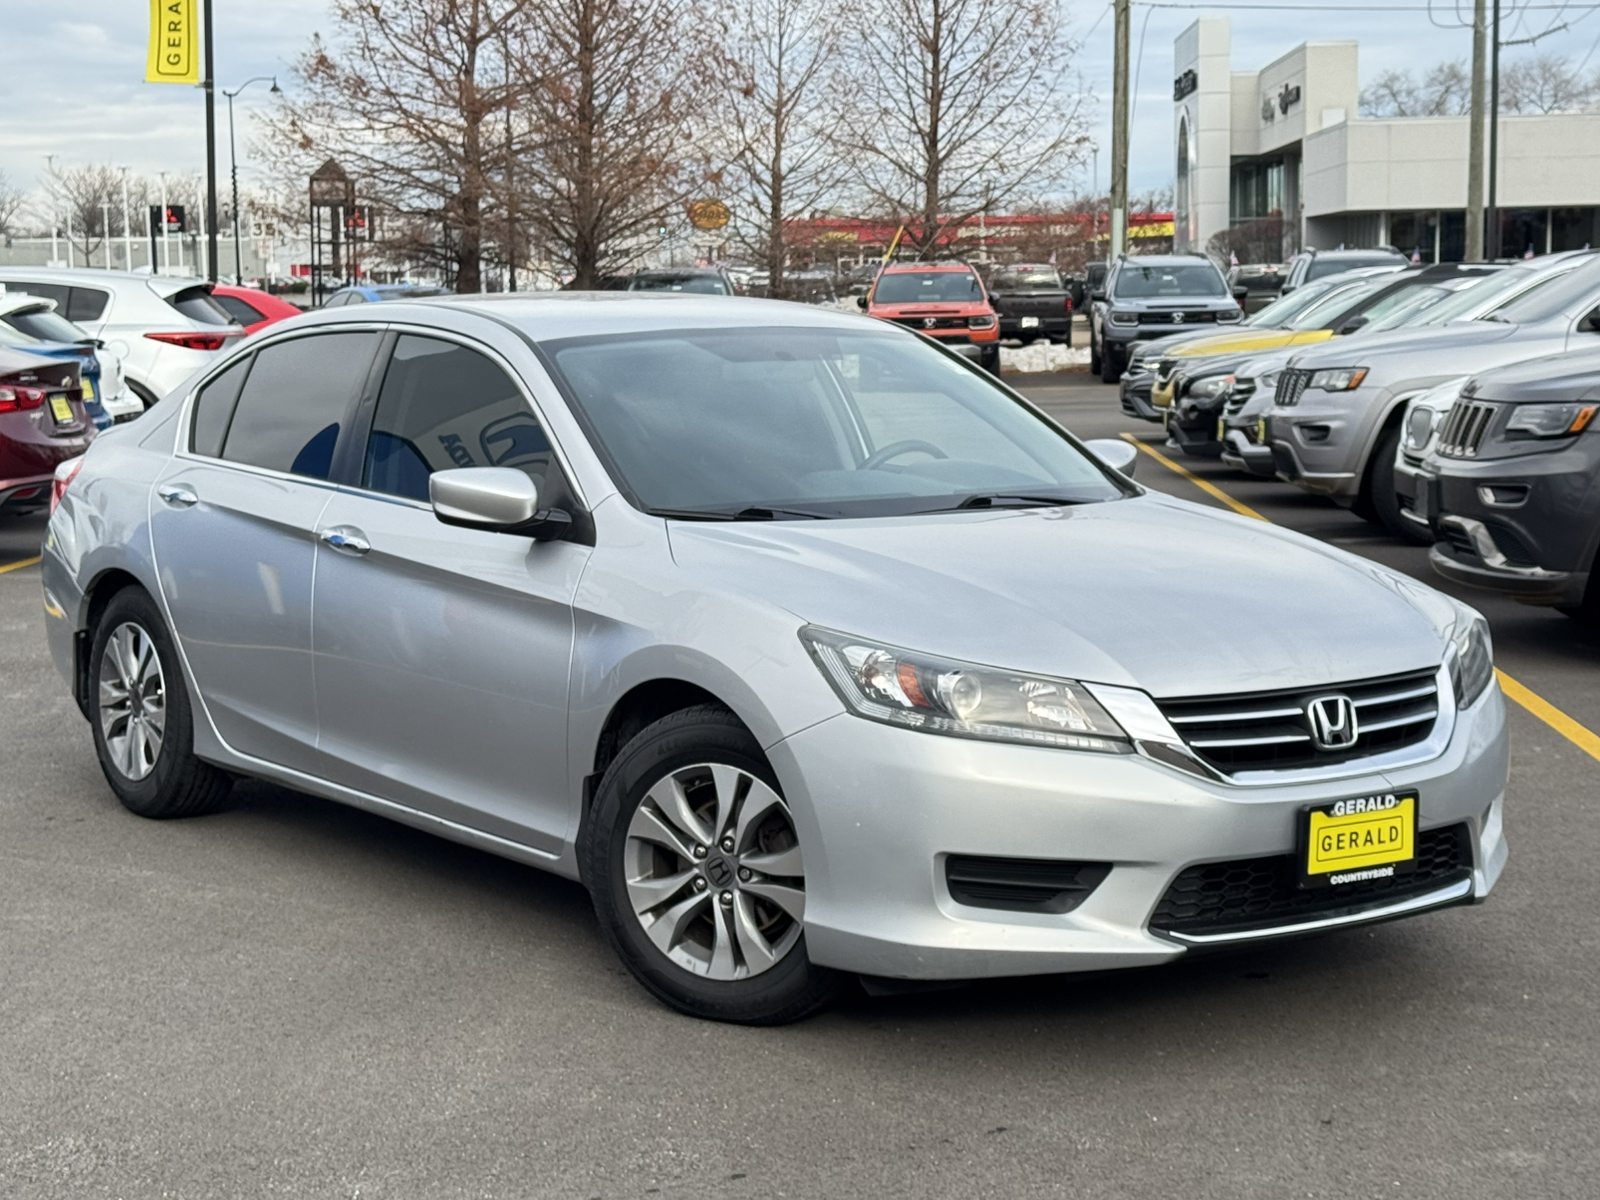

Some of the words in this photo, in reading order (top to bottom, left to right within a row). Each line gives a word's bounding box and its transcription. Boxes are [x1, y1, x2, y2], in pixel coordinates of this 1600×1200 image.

[1334, 794, 1396, 816] GERALD
[1321, 825, 1399, 853] GERALD
[1330, 866, 1394, 885] COUNTRYSIDE
